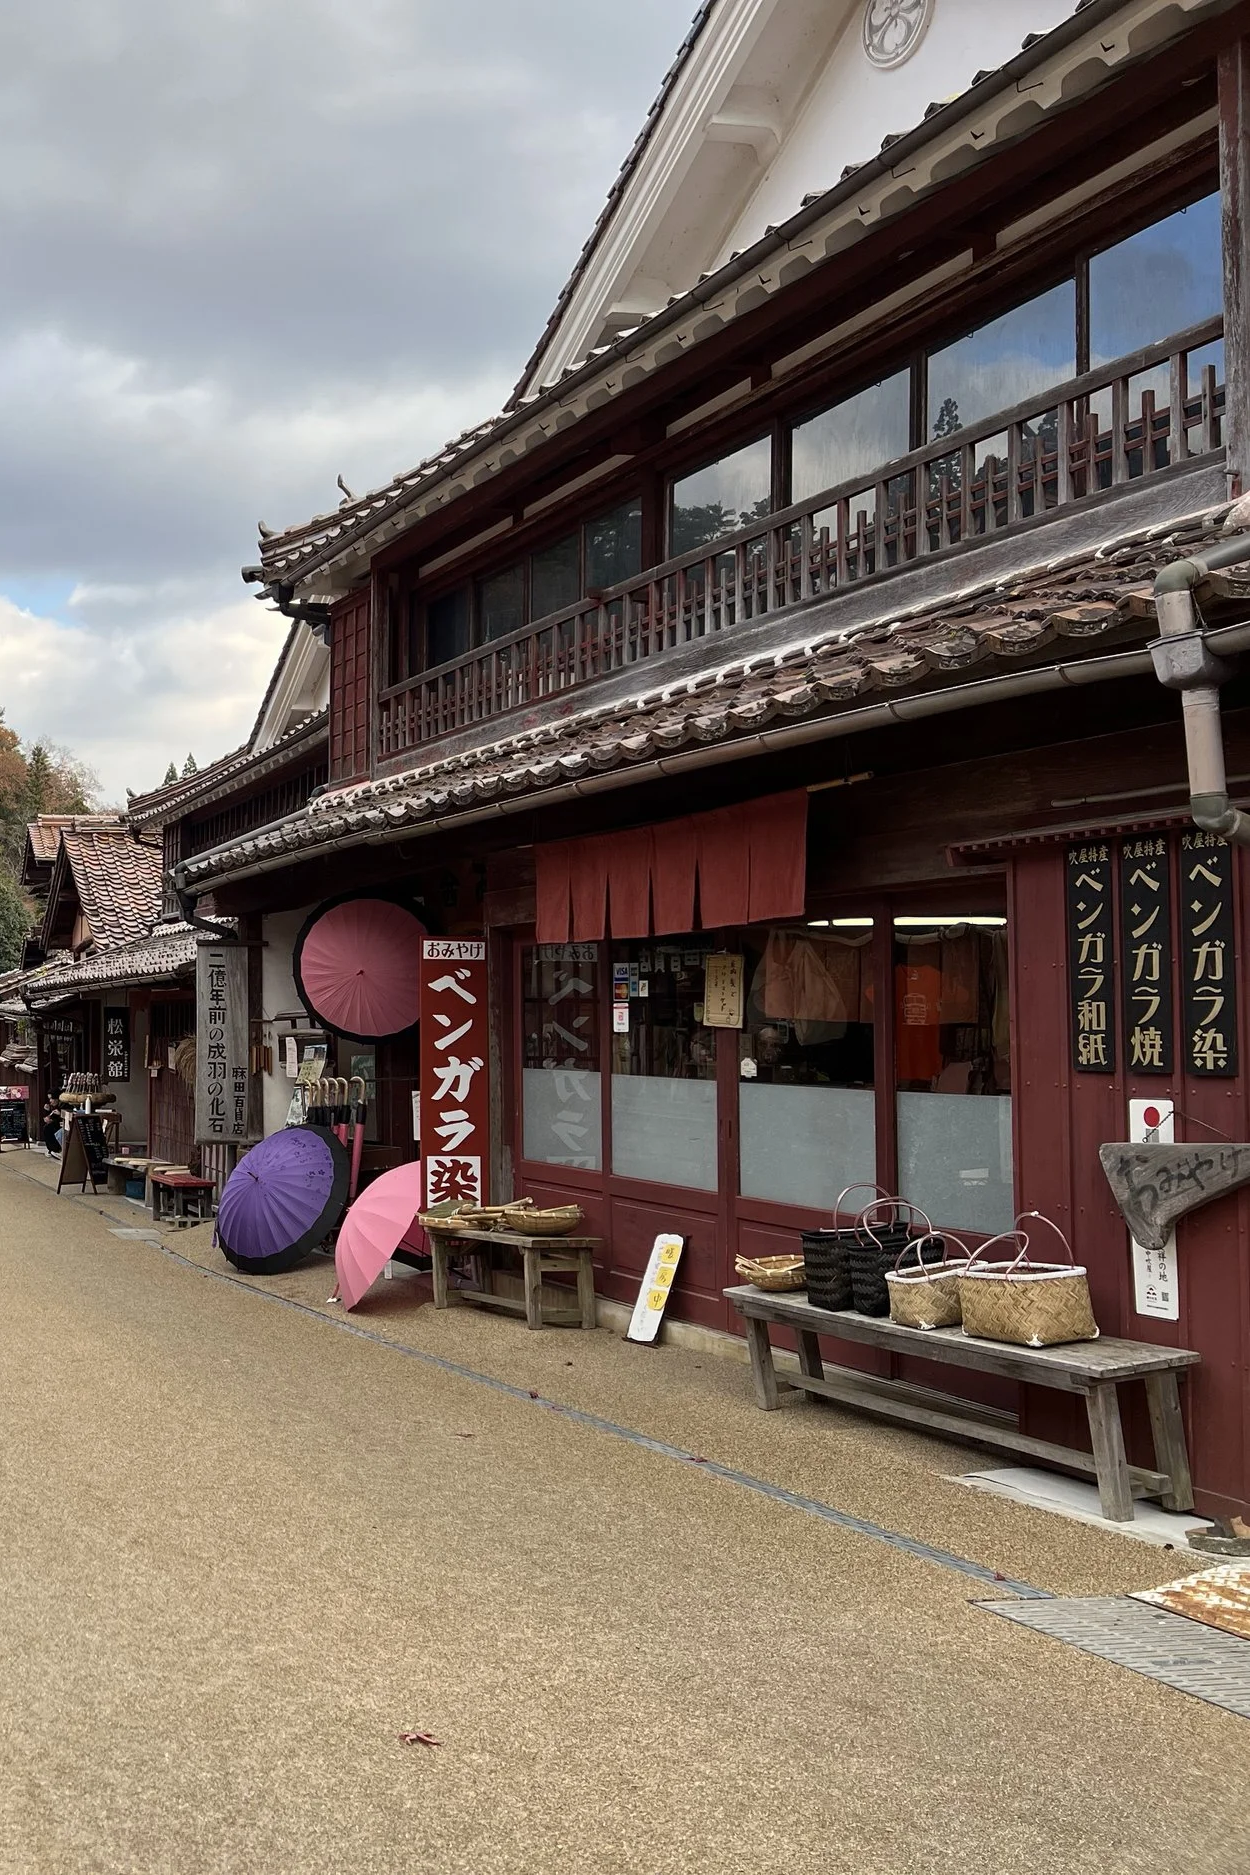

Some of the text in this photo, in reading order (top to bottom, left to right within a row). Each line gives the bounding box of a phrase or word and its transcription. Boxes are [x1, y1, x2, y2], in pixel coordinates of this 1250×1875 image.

[1068, 846, 1109, 866] 吹屋特産
[1123, 838, 1166, 860] 吹屋特産
[1182, 831, 1228, 850] 吹屋特産
[427, 942, 484, 959] おみやげ
[1074, 867, 1108, 1066] ベンガラ和紙
[1129, 861, 1164, 1067] ベンガラ焼
[1188, 855, 1228, 1070] ベンガラ染
[616, 967, 628, 976] VISA
[207, 953, 227, 1134] 二億年前の成羽の化石
[427, 967, 484, 1204] ベンガラ染
[1157, 1249, 1168, 1282] 祥の地
